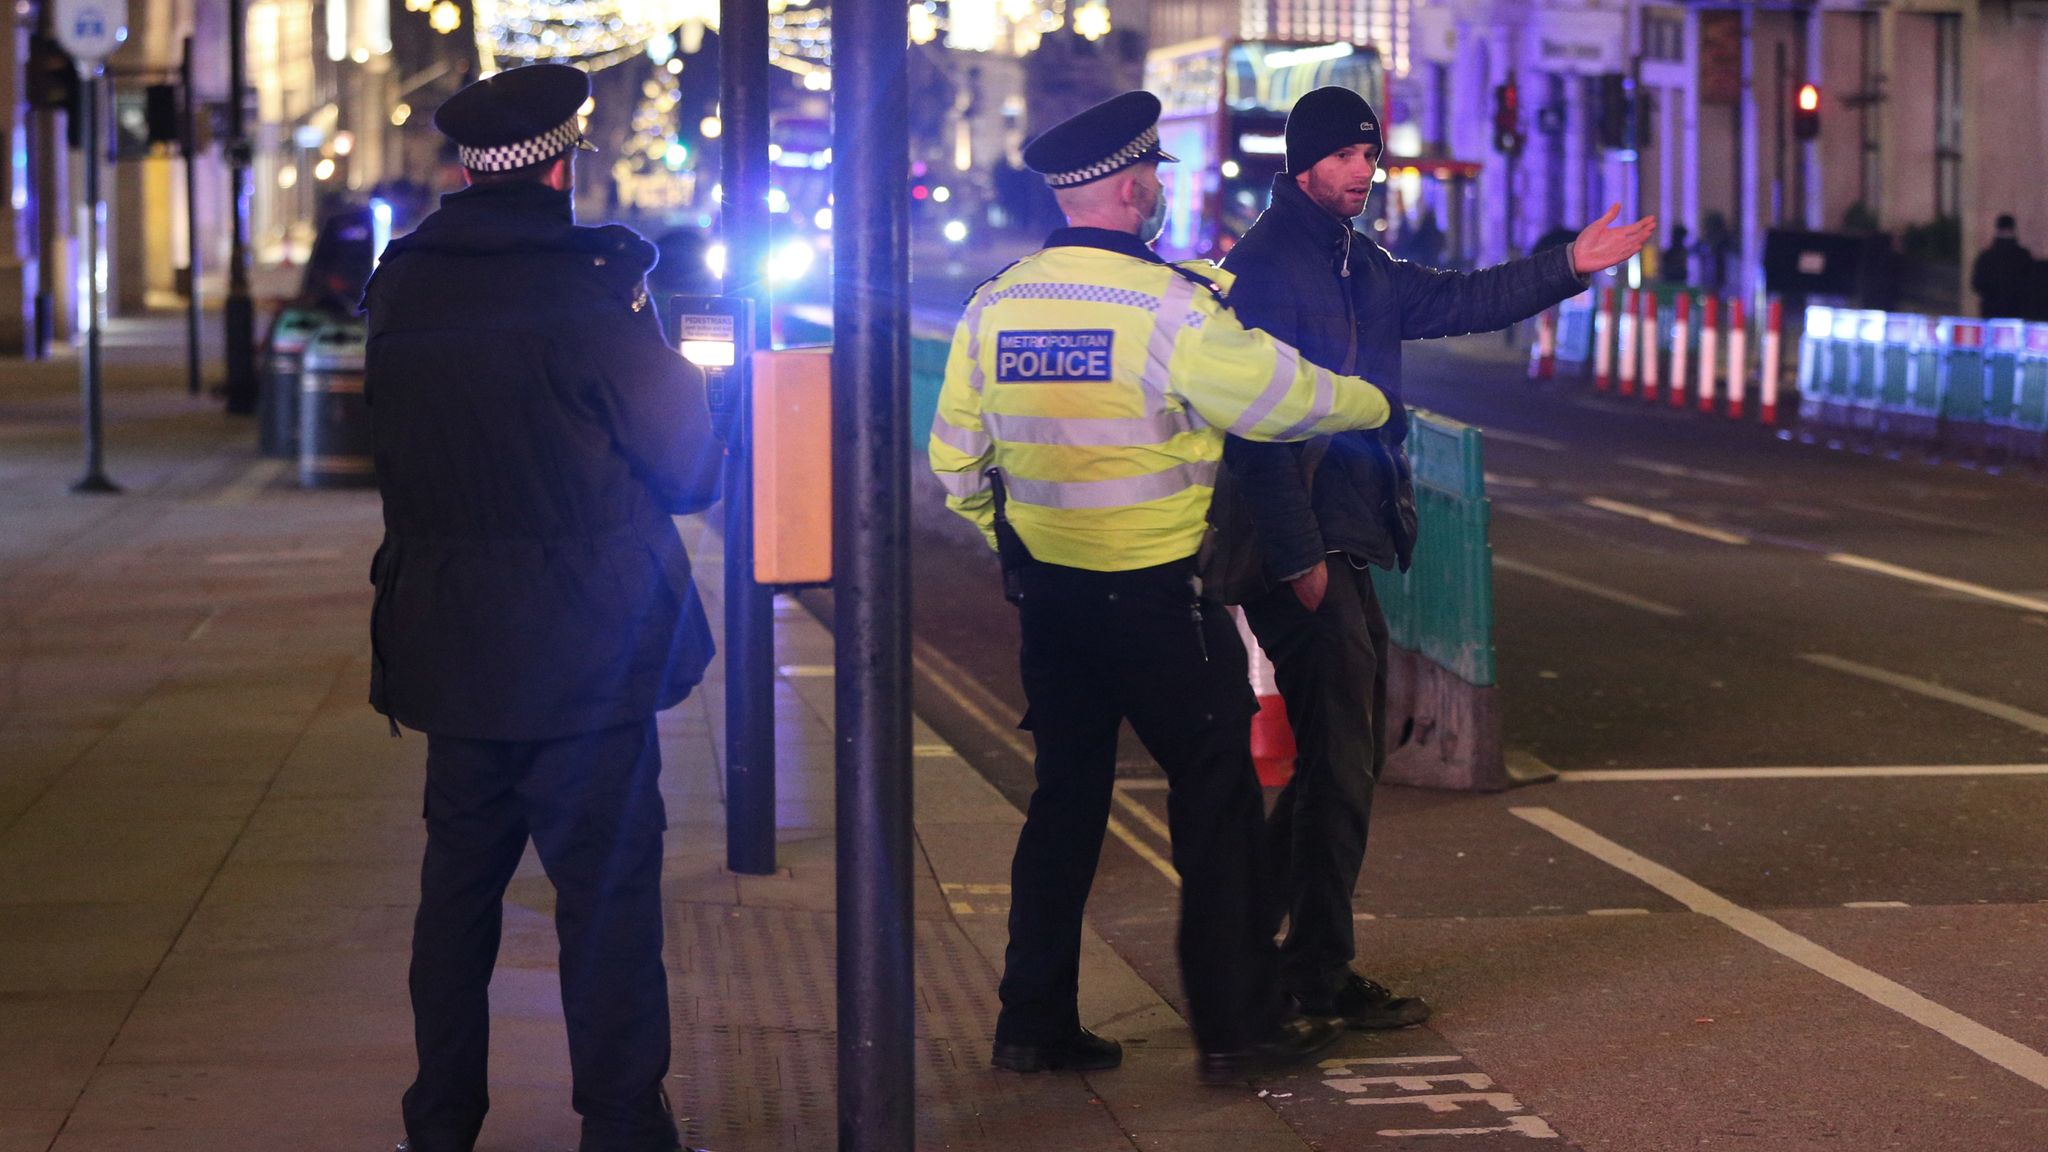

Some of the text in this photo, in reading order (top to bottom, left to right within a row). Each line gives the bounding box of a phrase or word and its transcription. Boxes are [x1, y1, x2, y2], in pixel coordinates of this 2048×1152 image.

[685, 316, 733, 325] PEDESTRIANS
[1001, 334, 1109, 349] METROPOLITAN
[1000, 351, 1107, 378] POLICE
